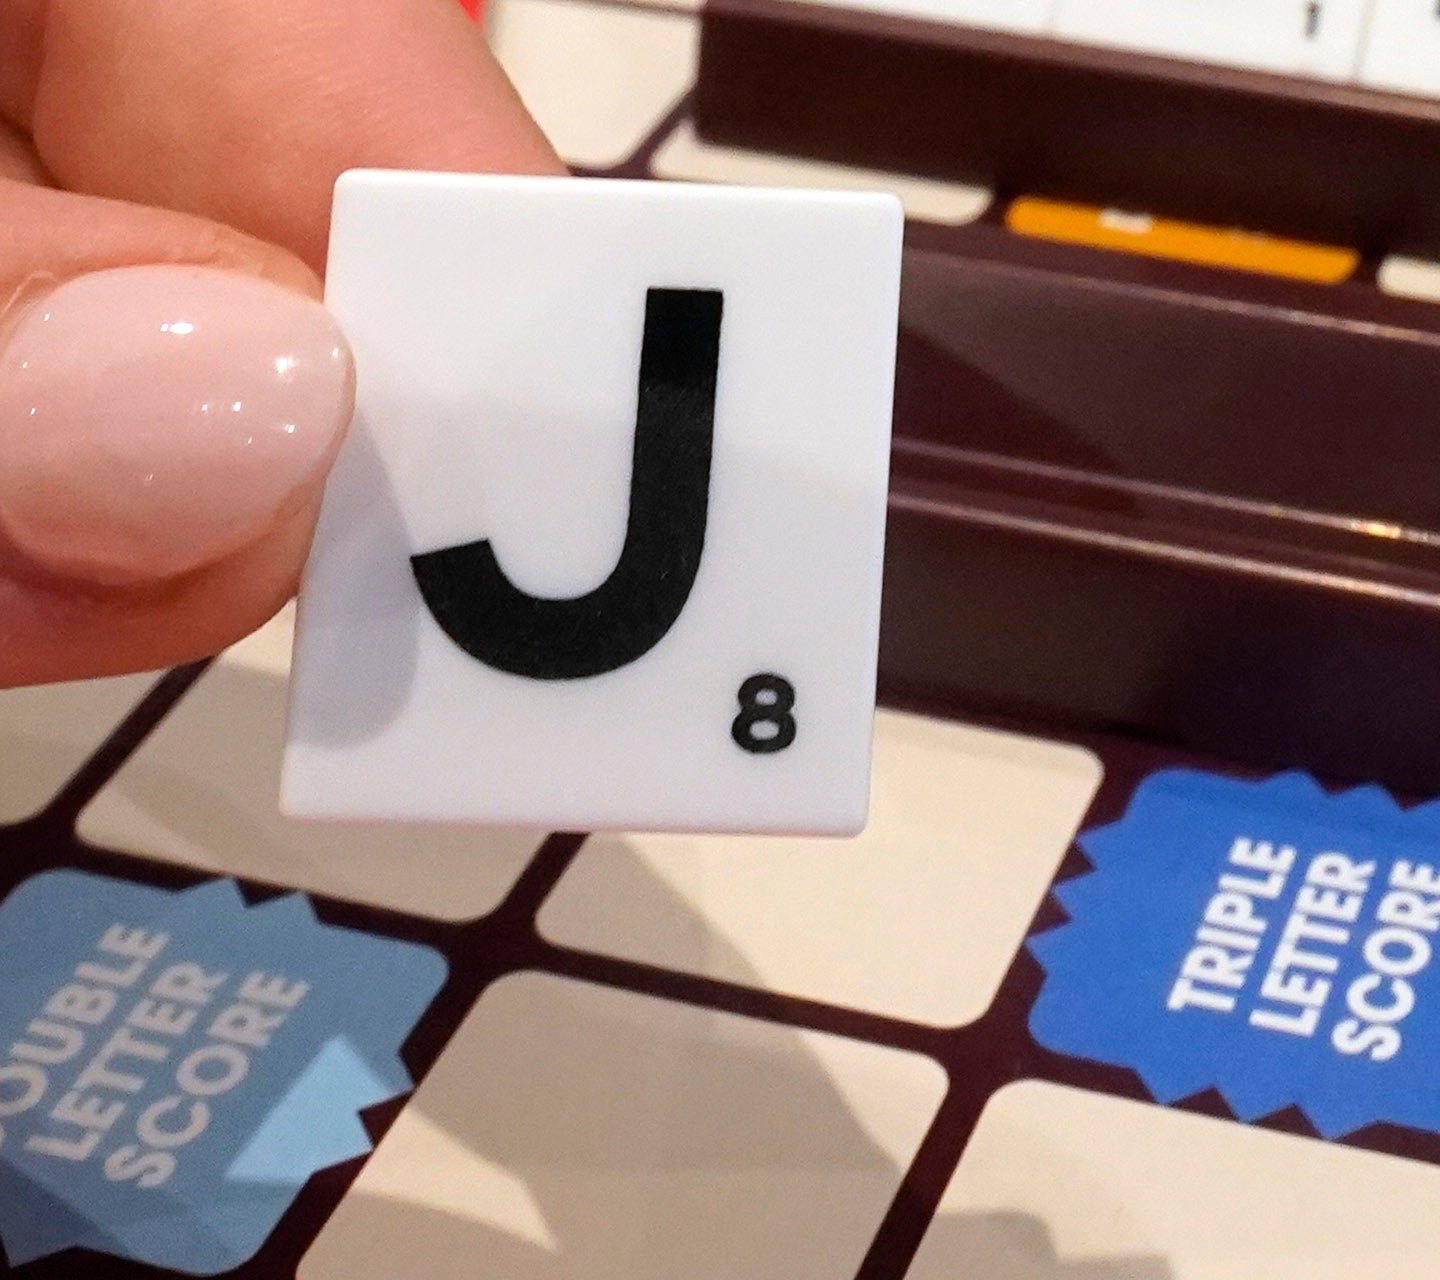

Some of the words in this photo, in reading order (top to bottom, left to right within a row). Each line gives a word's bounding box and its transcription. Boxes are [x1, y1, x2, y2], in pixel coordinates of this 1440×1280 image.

[1304, 0, 1320, 39] 1
[409, 287, 724, 681] J
[730, 671, 797, 754] 8
[1167, 836, 1295, 1013] TRIPLE
[1250, 850, 1375, 1037] LETTER
[24, 961, 228, 1161] LETTER
[103, 970, 312, 1189] SCORE
